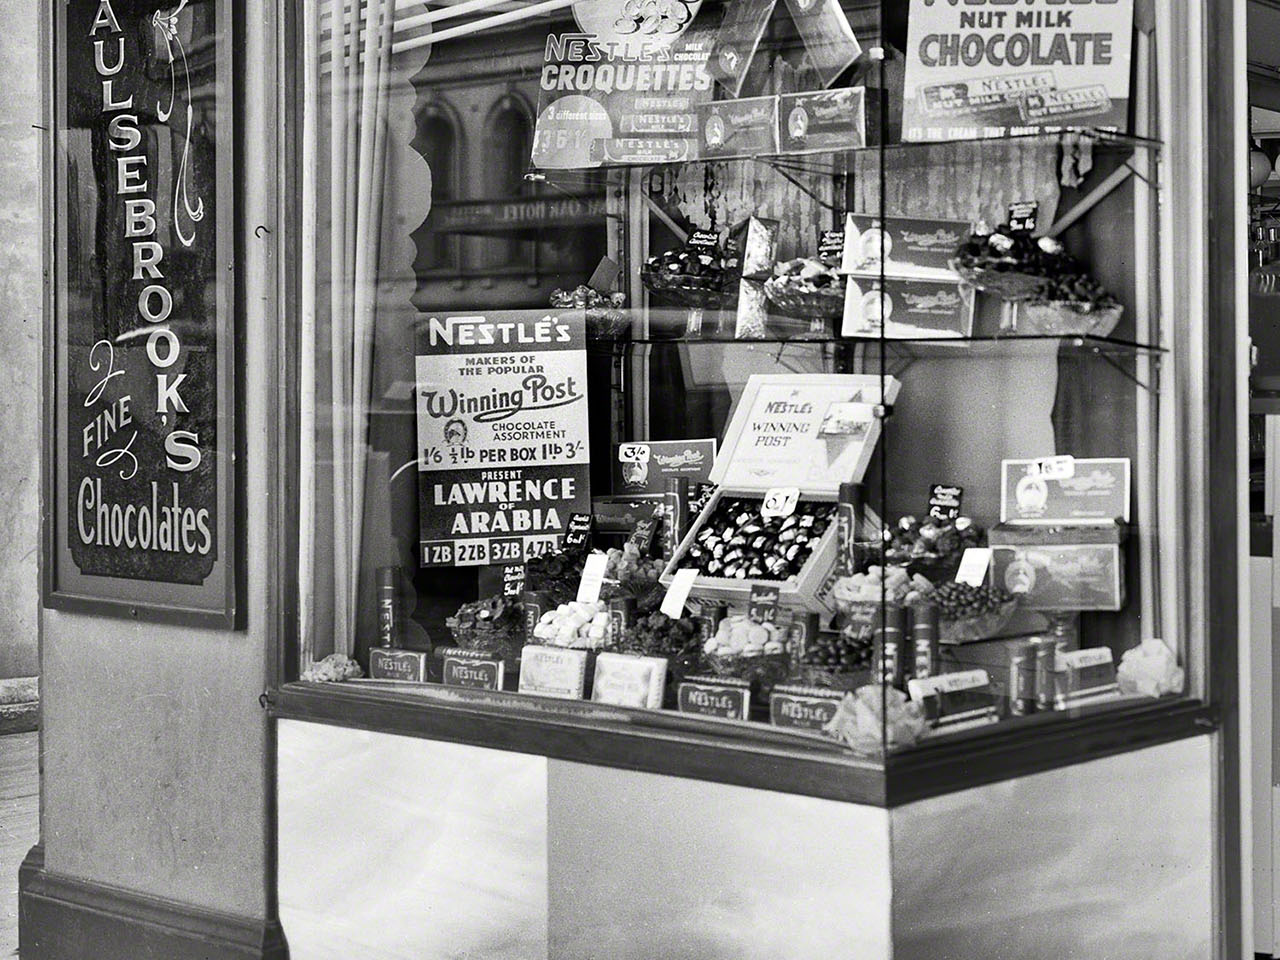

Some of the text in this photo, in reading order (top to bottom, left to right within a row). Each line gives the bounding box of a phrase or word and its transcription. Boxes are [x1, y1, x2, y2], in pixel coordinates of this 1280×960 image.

[959, 10, 1074, 28] NUT MILK
[684, 42, 704, 52] MILK
[918, 32, 1113, 67] CHOCOLATE
[673, 52, 714, 62] CHOCOLAT
[540, 63, 713, 95] CROQUETTES
[465, 355, 536, 366] MAKERS OF
[458, 364, 545, 376] THE POPULAR
[421, 373, 577, 423] Winning Post
[82, 394, 133, 458] FINE
[491, 420, 556, 431] CHOCOLATE
[752, 421, 811, 434] WINNING
[493, 429, 567, 441] ASSORTMENT
[754, 435, 792, 447] POST
[479, 446, 507, 463] PER
[510, 445, 537, 462] BOX
[481, 469, 523, 481] PRESENT
[433, 477, 576, 506] LAWRENCE
[498, 501, 515, 511] OF
[77, 476, 212, 555] Chocolates
[451, 507, 562, 535] ARABIA
[424, 545, 452, 564] 1ZB
[457, 543, 487, 562] 2ZB
[491, 541, 522, 560] 3ZB
